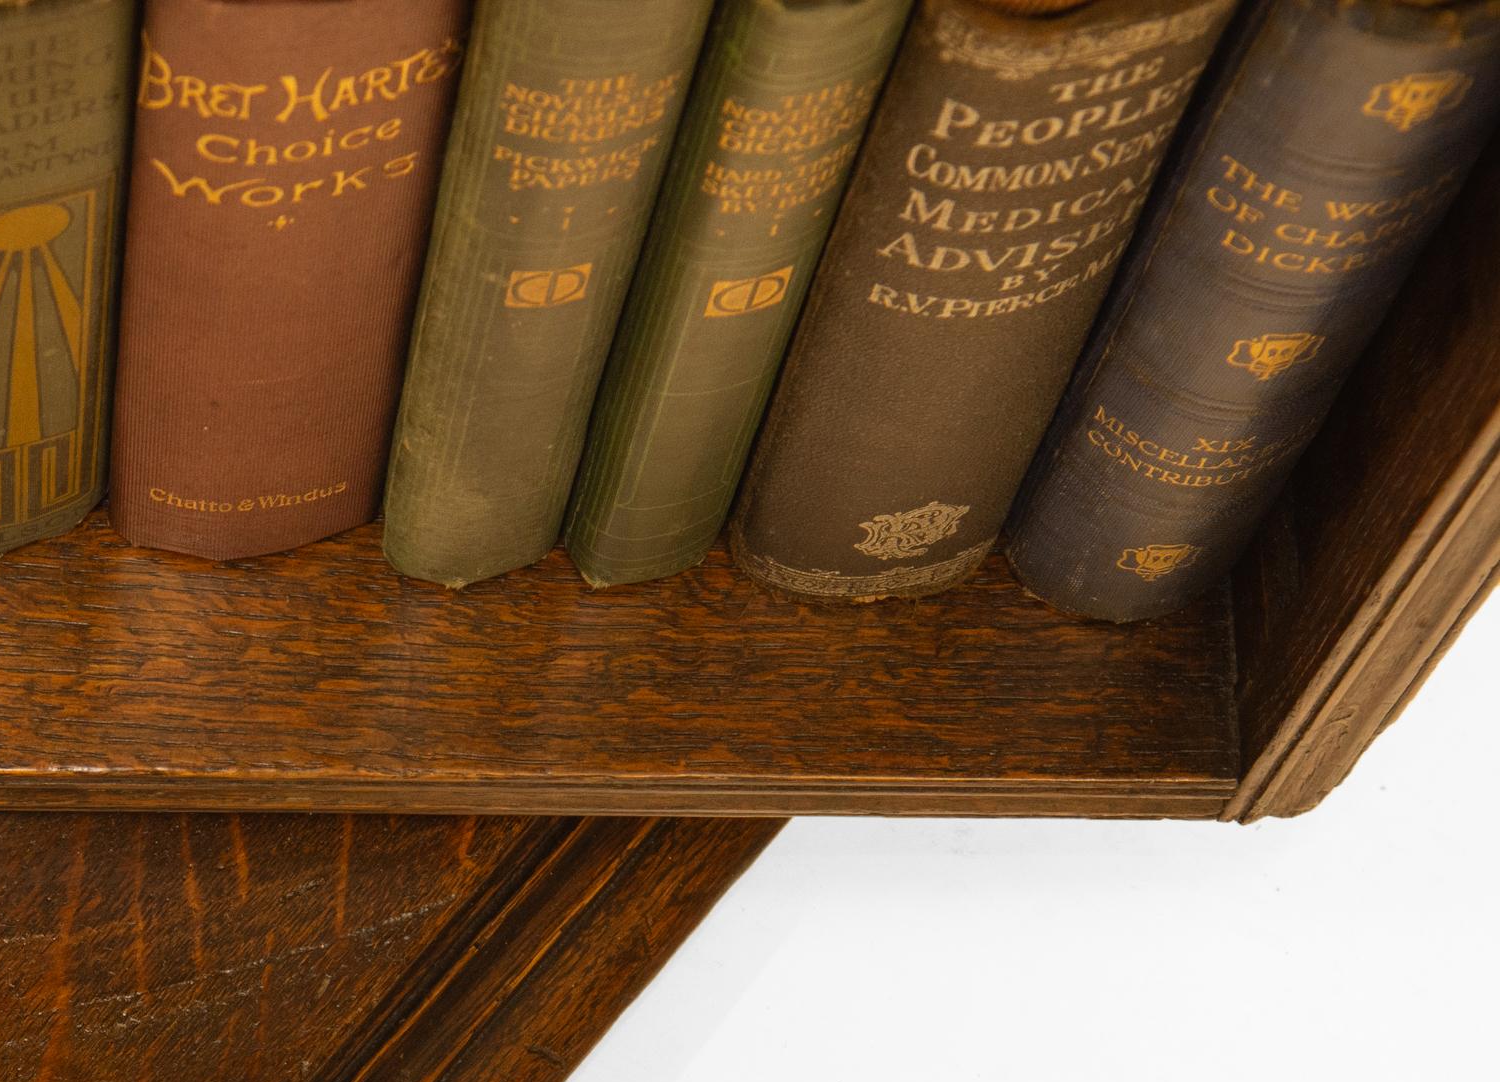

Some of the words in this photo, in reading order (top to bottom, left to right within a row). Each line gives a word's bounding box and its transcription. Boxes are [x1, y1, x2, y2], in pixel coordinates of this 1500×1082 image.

[137, 28, 268, 120] BRET
[1051, 56, 1165, 102] THE
[906, 143, 1083, 193] COMMON
[1220, 154, 1303, 213] THE
[1206, 184, 1266, 225] OF
[1000, 263, 1062, 292] BY
[149, 487, 233, 513] Chatto
[258, 481, 348, 510] Windus
